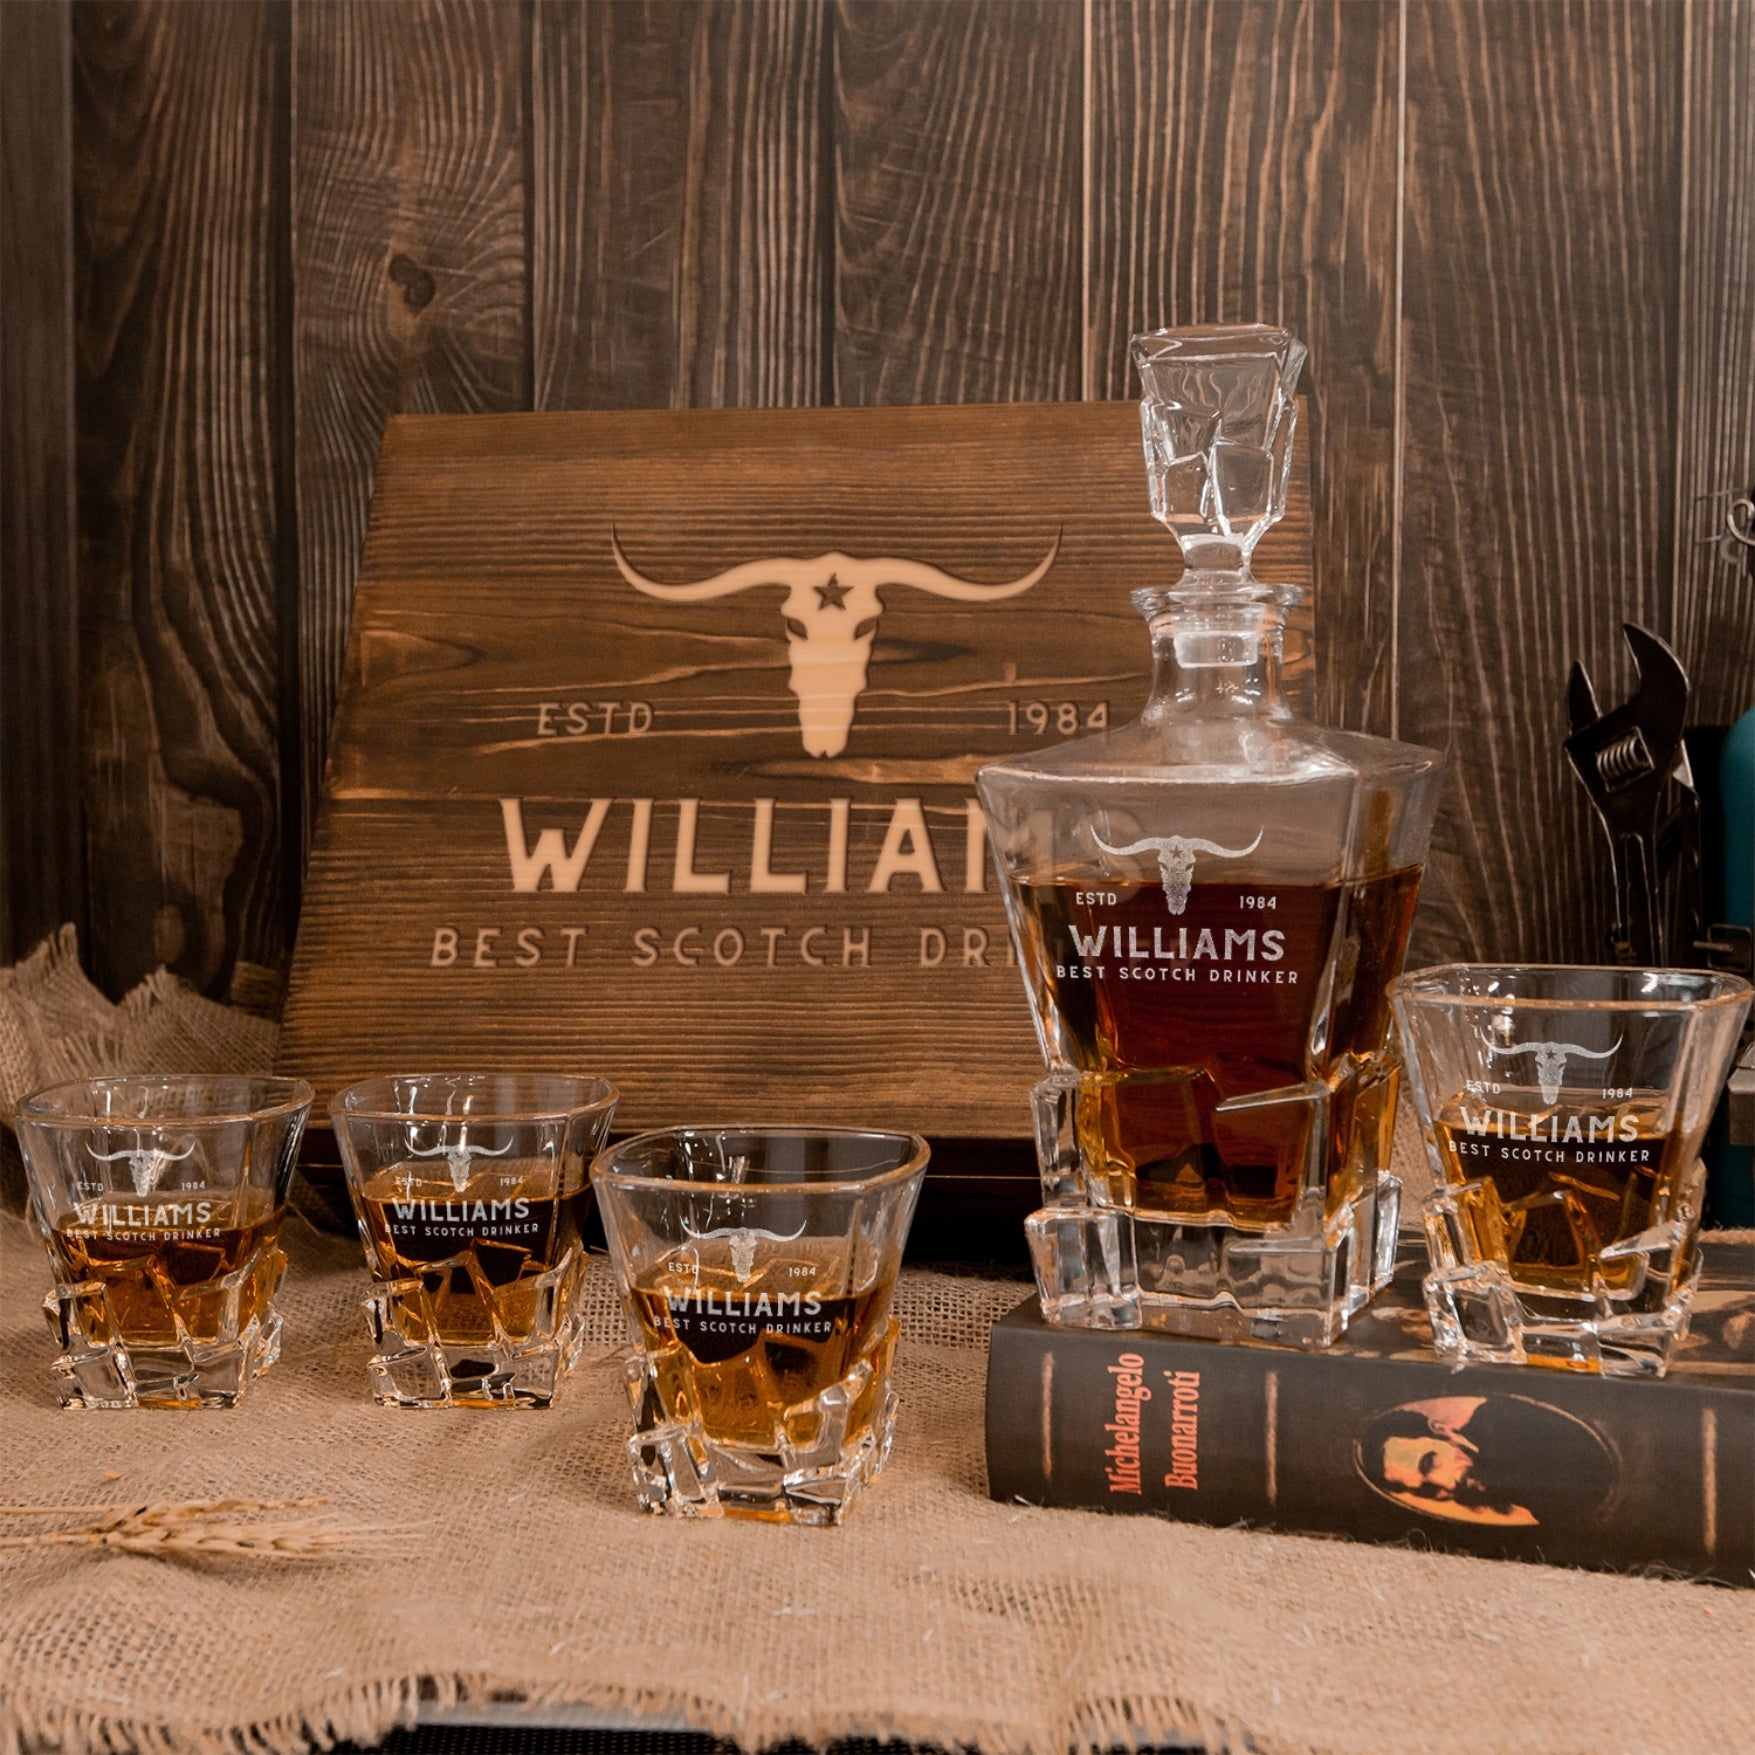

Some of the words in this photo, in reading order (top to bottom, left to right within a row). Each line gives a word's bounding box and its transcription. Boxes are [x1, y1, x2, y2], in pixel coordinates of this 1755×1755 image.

[537, 701, 655, 735] ESTD
[1009, 701, 1110, 740] 1984
[1076, 891, 1117, 906] ESTD
[1239, 895, 1277, 910] 1984
[430, 926, 588, 967] BEST
[632, 926, 871, 967] SCOTCH
[1068, 924, 1286, 961] WILLIAMS
[1056, 965, 1106, 979] BEST
[1119, 967, 1196, 981] SCOTCH
[1209, 969, 1298, 984] DRINKER
[1466, 1079, 1501, 1094] ESTD
[1602, 1087, 1633, 1099] 1984
[1459, 1106, 1640, 1144] WILLIAMS
[1449, 1140, 1490, 1157] BEST
[1501, 1147, 1565, 1163] SCOTCH
[1575, 1149, 1650, 1163] DRINKER
[77, 1181, 104, 1192] ESTD
[181, 1180, 206, 1191] 1984
[500, 1175, 523, 1186] 1984
[73, 1202, 212, 1226] WILLIAMS
[392, 1197, 530, 1222] WILLIAMS
[66, 1229, 98, 1240] BEST
[107, 1230, 156, 1241] SCOTCH
[164, 1227, 220, 1241] DRINKER
[385, 1223, 416, 1235] BEST
[425, 1226, 474, 1237] SCOTCH
[482, 1223, 539, 1236] DRINKER
[788, 1266, 816, 1277] 1984
[663, 1285, 823, 1317] WILLIAMS
[653, 1316, 690, 1330] BEST
[700, 1321, 756, 1334] SCOTCH
[766, 1321, 832, 1334] DRINKER
[1105, 1353, 1152, 1495] Michelangelo
[1163, 1369, 1200, 1490] Buonarroti
